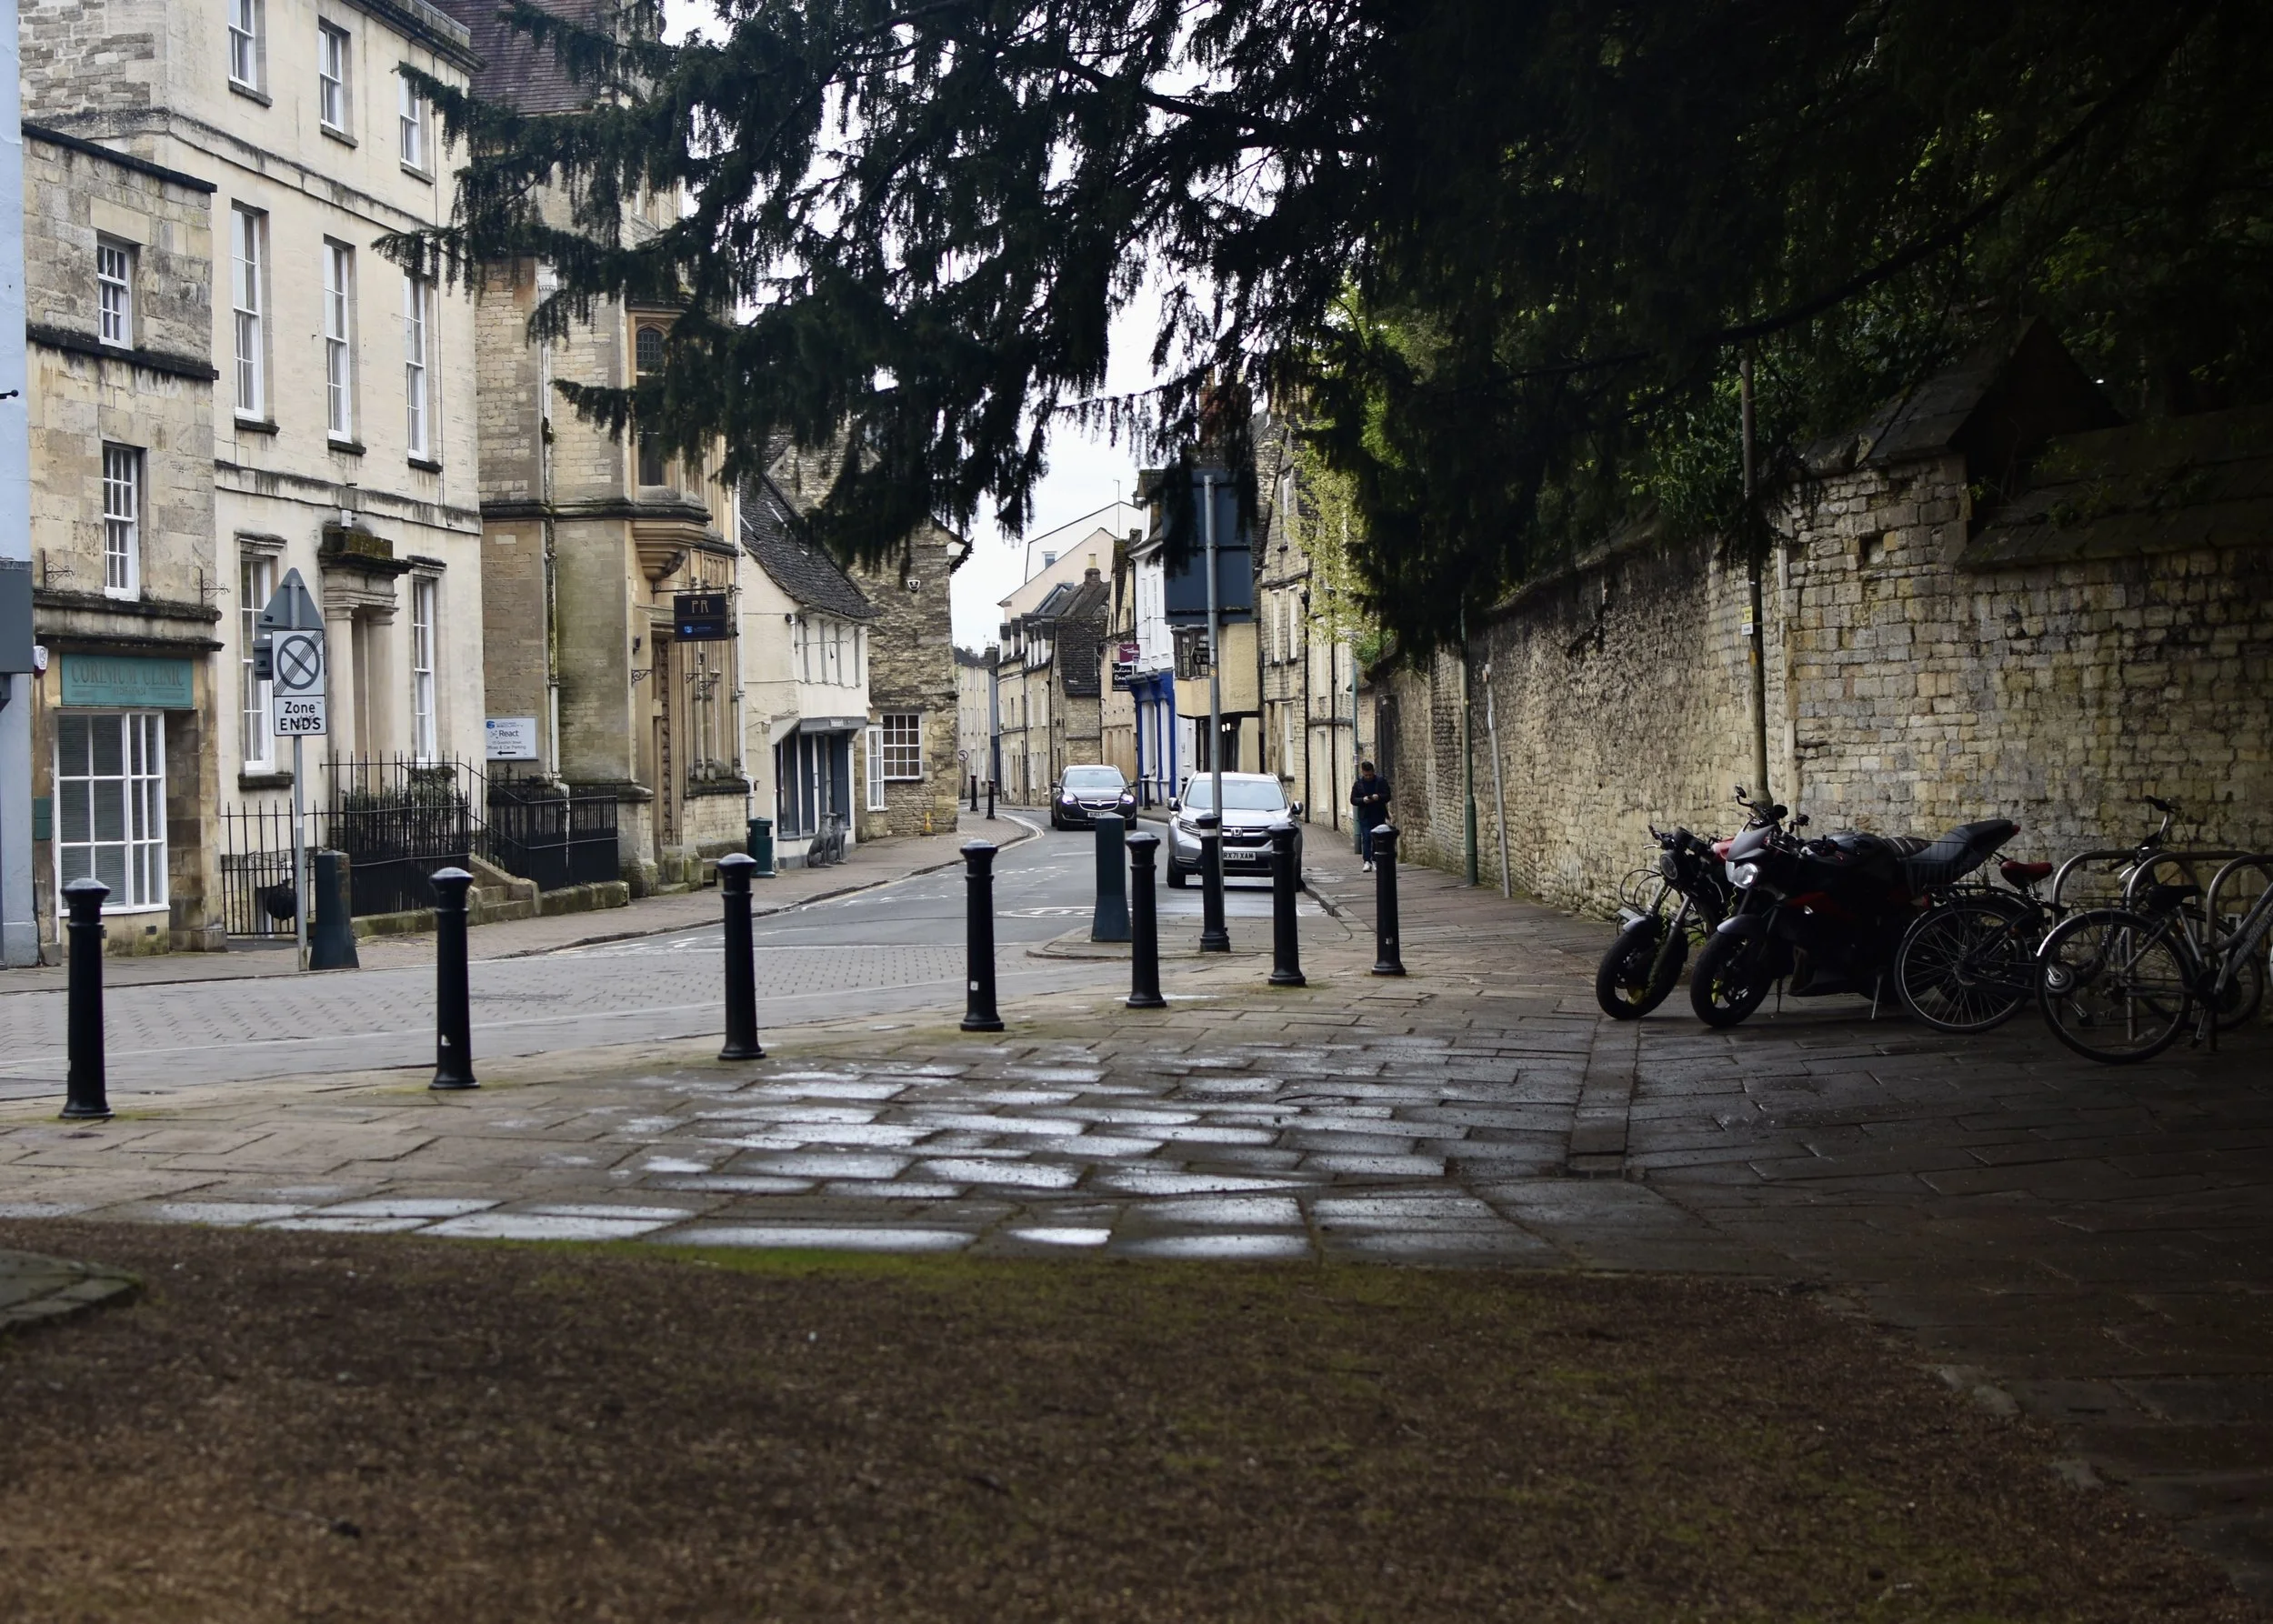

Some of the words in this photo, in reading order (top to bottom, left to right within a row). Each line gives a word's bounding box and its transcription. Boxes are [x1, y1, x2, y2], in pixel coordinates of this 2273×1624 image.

[691, 600, 709, 614] PR
[72, 661, 138, 684] CORINIUM
[143, 665, 185, 687] CLINIC
[285, 701, 316, 714] Zone
[280, 717, 321, 731] ENDS
